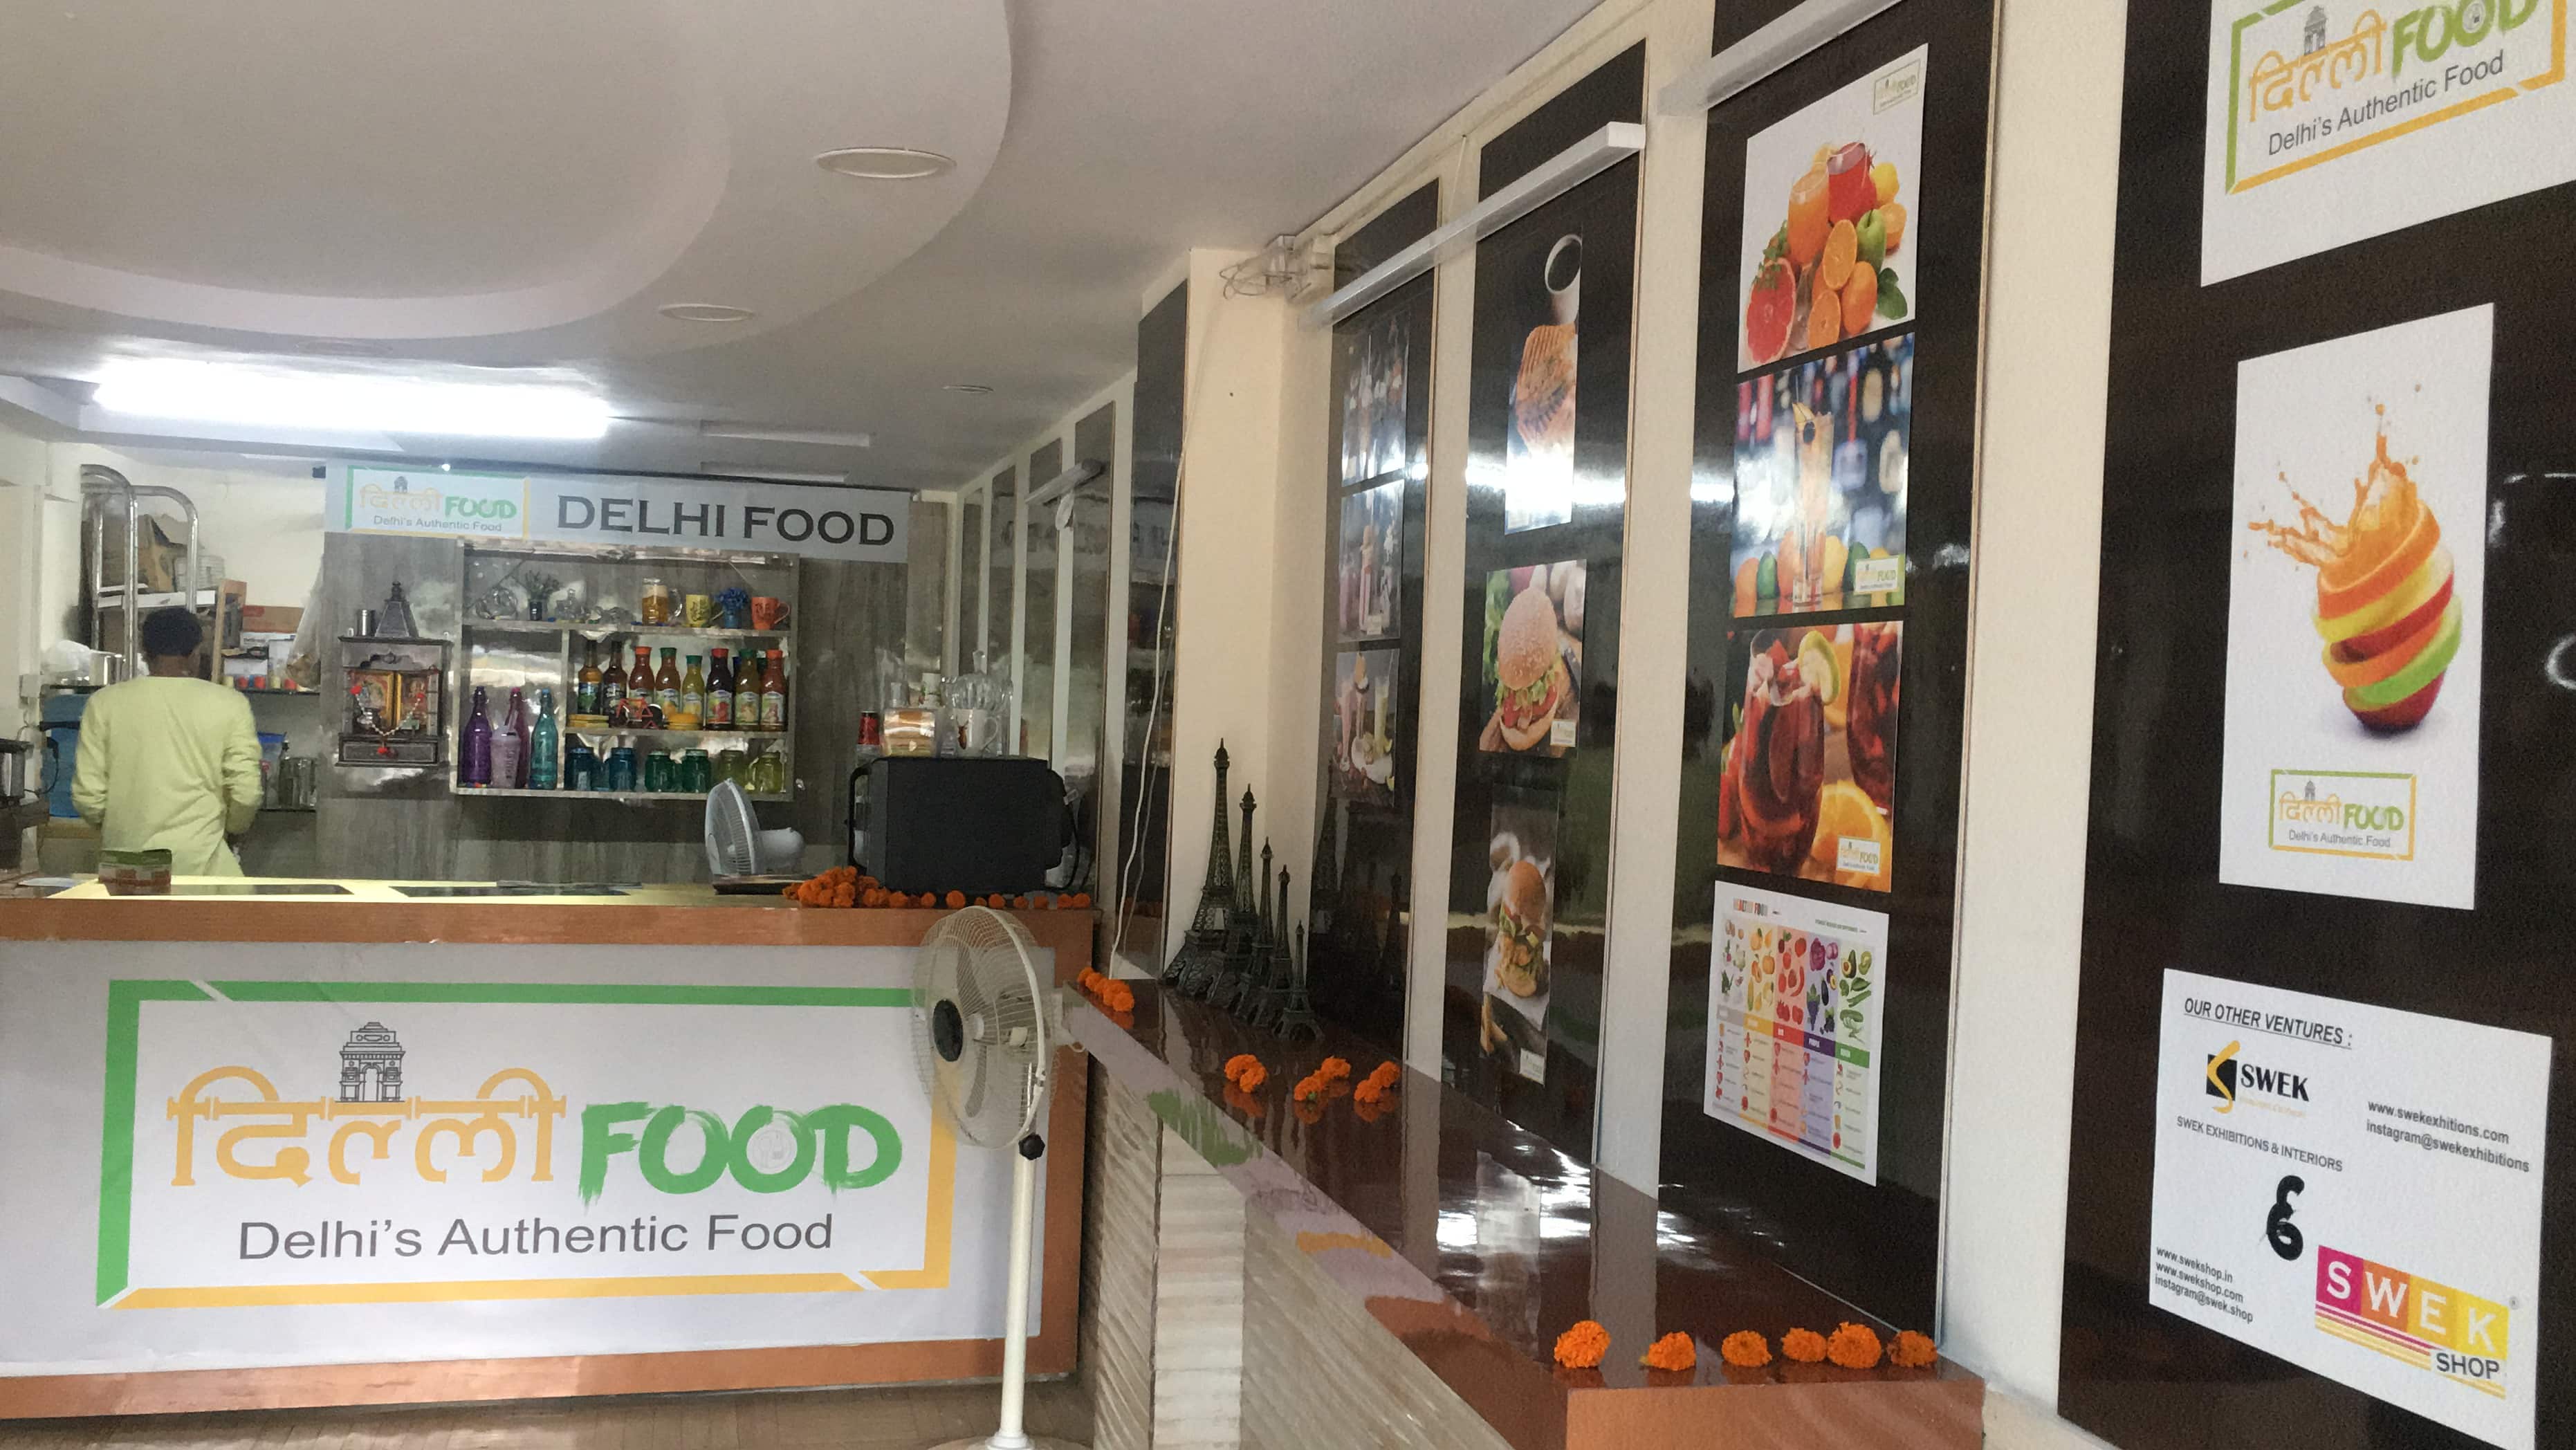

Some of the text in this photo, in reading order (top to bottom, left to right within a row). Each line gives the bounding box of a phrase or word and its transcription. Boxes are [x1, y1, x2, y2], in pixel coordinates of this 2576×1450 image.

[2269, 48, 2503, 155] Delhi's Authentic Food
[416, 517, 470, 530] Authentic
[473, 521, 502, 531] Food
[444, 496, 517, 519] FOOD
[558, 495, 894, 545] DELHI FOOD
[2343, 803, 2404, 831] FOOD
[2320, 833, 2363, 846] Authentic
[2366, 835, 2391, 847] Food
[2184, 998, 2211, 1017] OUR
[2215, 1004, 2260, 1027] OTHER
[2265, 1013, 2343, 1044] VENTURES
[2241, 1063, 2310, 1102] SWEK
[167, 1065, 902, 1212] दिल्ली FOOD
[2177, 1116, 2343, 1172] SWEK EXHIBITIONS & INTERIORS
[2368, 1101, 2509, 1144] www.swekexhitions.com
[2366, 1119, 2530, 1173] instagram@swekexhibitions
[438, 1215, 688, 1256] Authentic
[708, 1213, 832, 1250] Food
[2156, 1247, 2233, 1283] www.swekshop.in
[2156, 1261, 2243, 1303] www.swekshop.com
[2155, 1274, 2253, 1324] instagram@swek.shop
[2326, 1261, 2496, 1352] SWEK
[2436, 1352, 2499, 1379] SHOP
